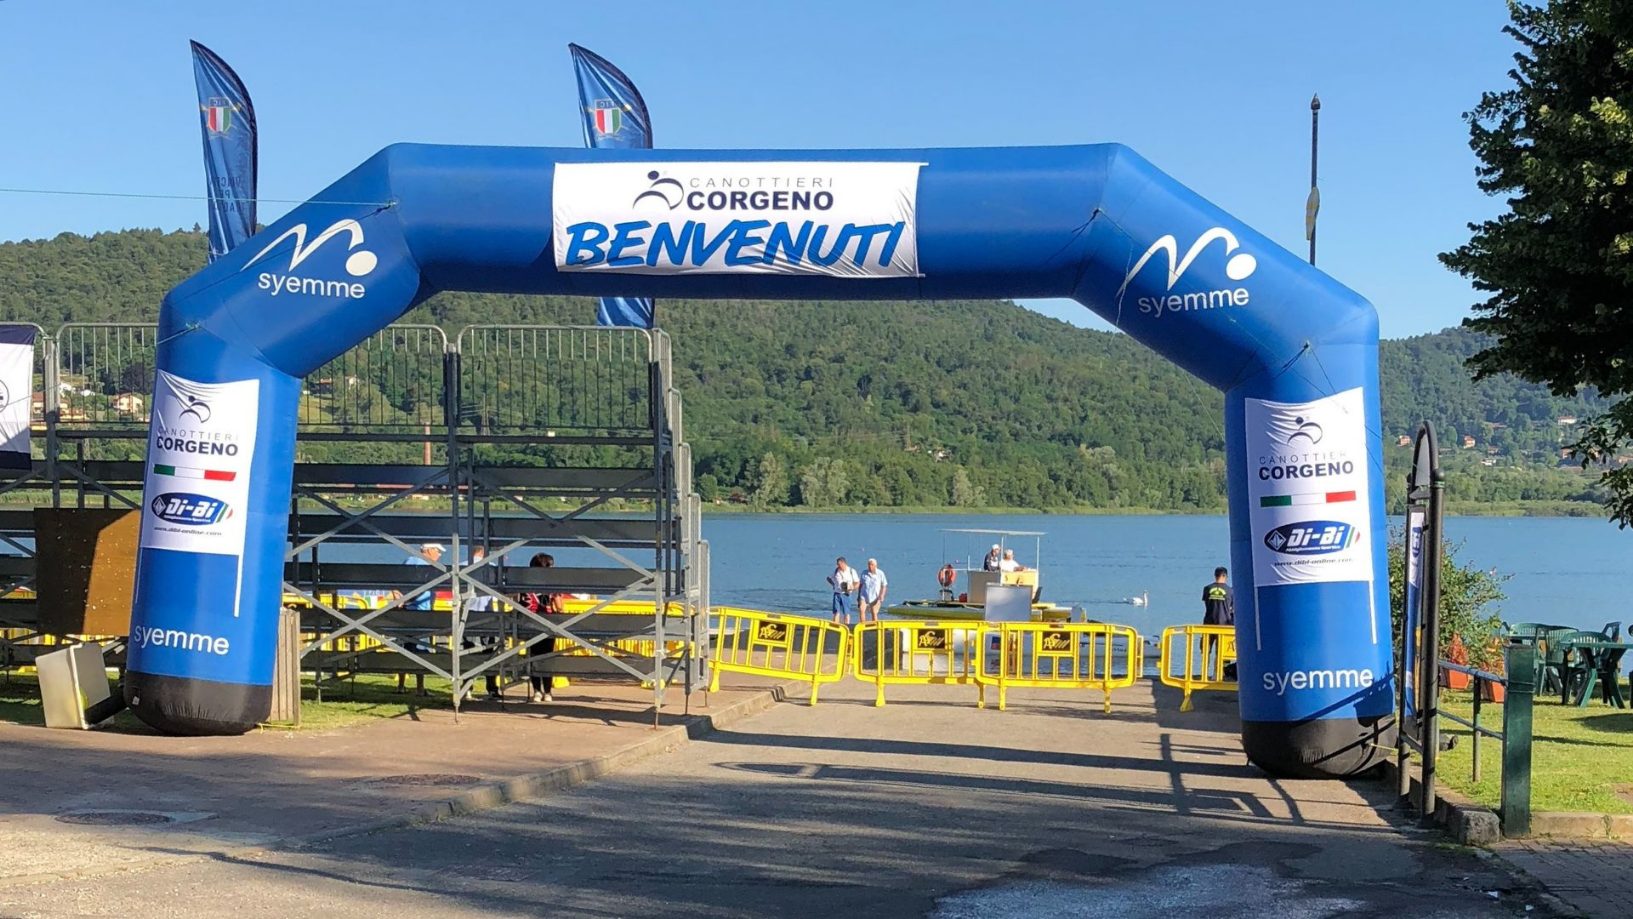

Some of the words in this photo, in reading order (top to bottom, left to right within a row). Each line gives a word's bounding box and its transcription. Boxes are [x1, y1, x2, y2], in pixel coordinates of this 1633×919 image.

[689, 176, 834, 189] CANOTTIERI
[686, 190, 834, 211] CORGENO
[565, 219, 905, 268] BENVENUTI
[257, 271, 365, 299] syemme
[1138, 287, 1249, 318] syemme
[156, 436, 238, 456] CORGENO
[1258, 460, 1354, 481] CORGENO
[134, 624, 230, 656] syemme
[1263, 667, 1373, 696] syemme
